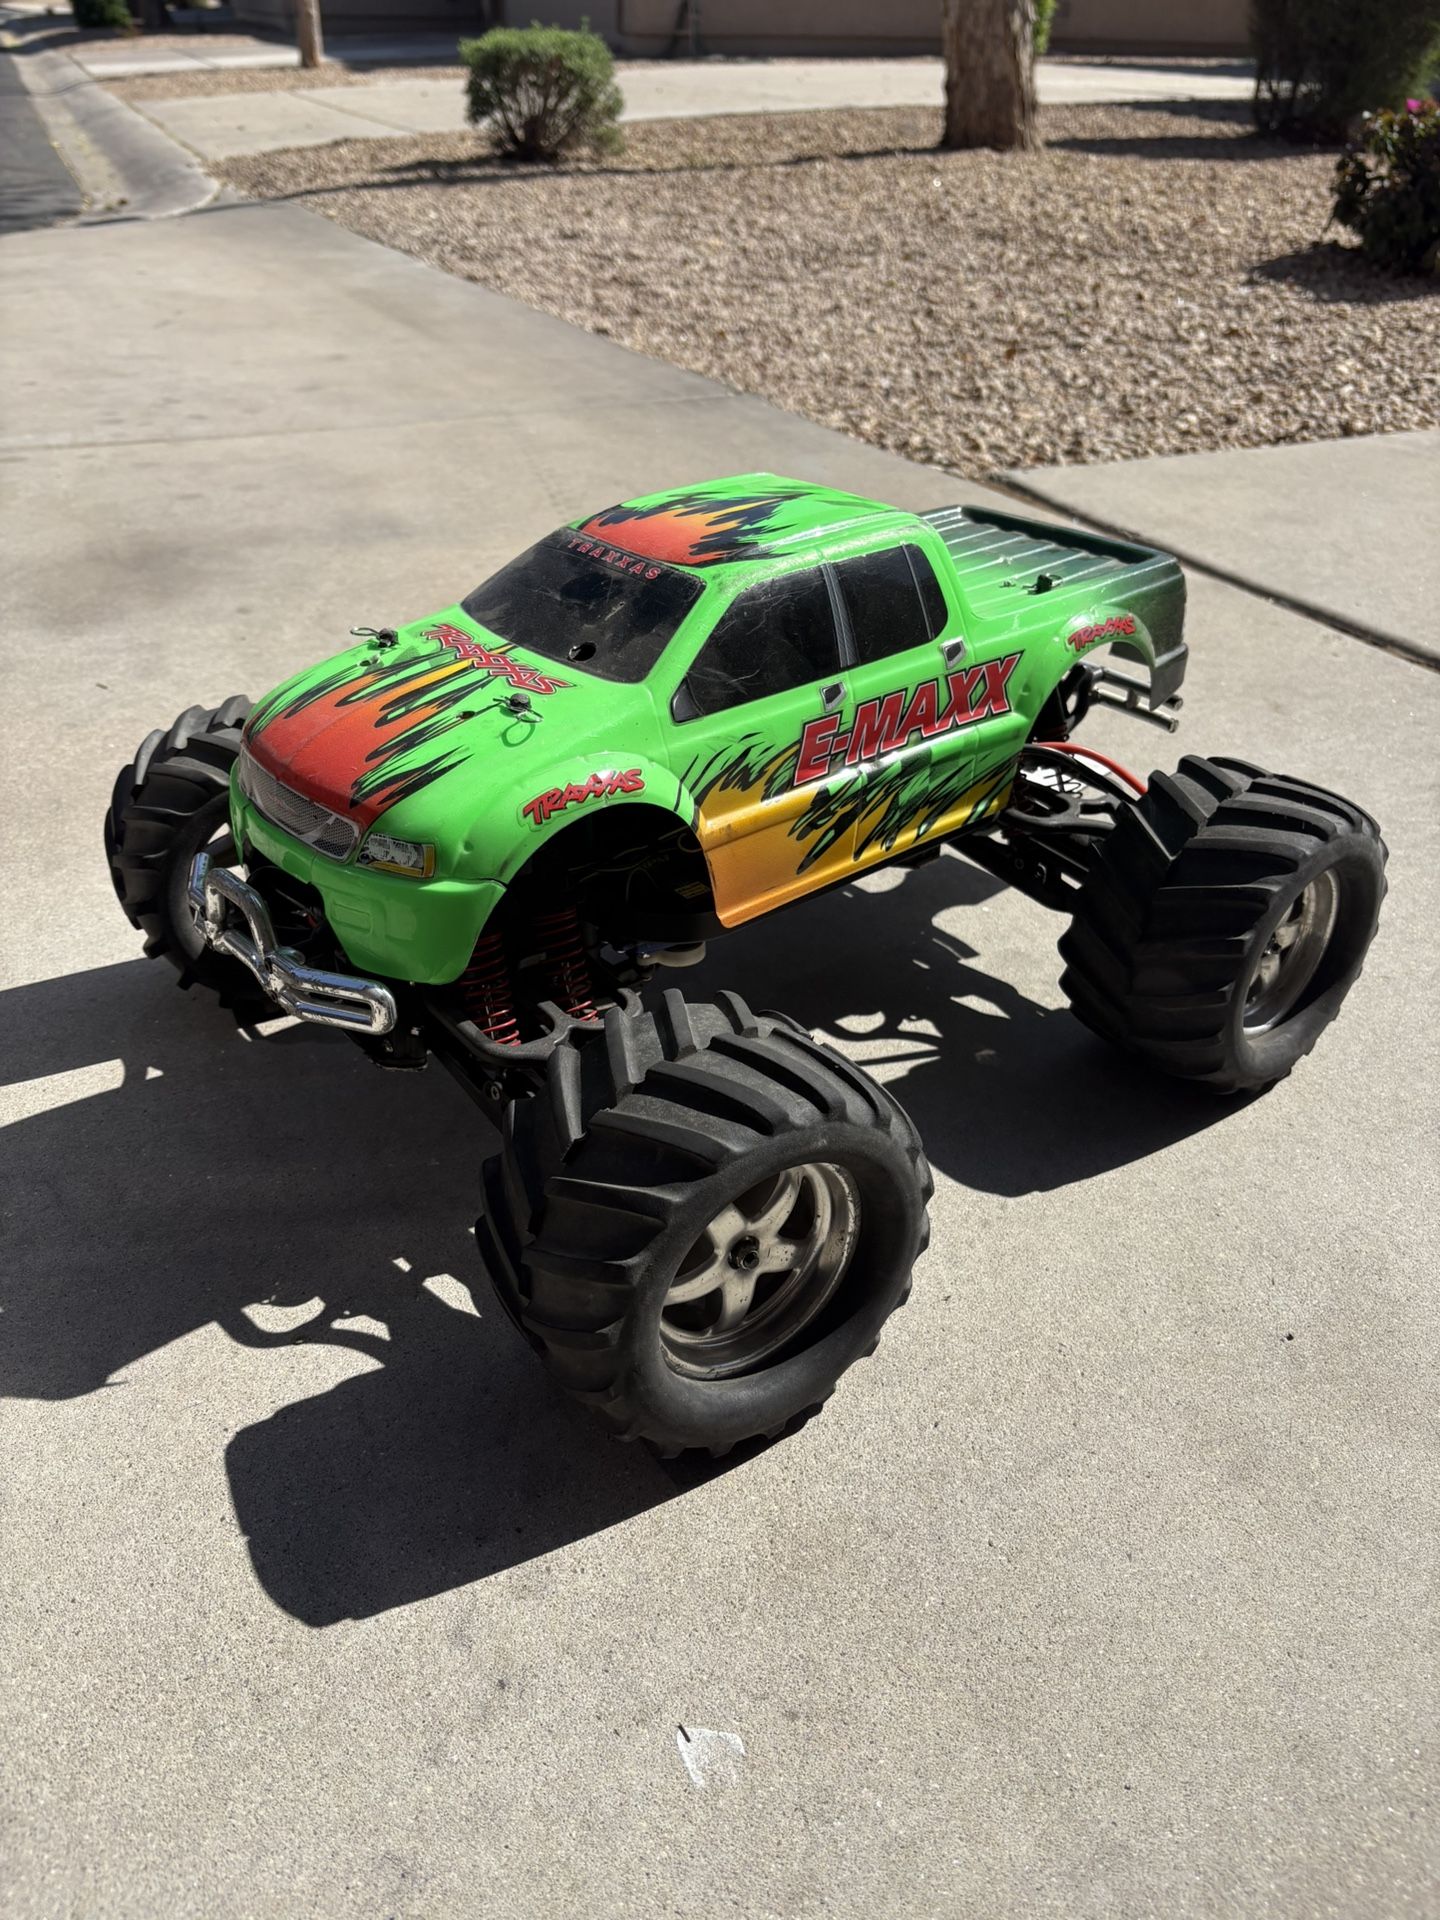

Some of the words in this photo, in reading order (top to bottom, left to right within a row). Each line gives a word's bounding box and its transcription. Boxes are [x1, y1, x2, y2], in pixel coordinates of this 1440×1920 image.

[568, 537, 661, 581] TRAXXAS
[421, 623, 575, 695] TRAXXAS
[1067, 616, 1136, 652] TRAXXAS
[793, 649, 1025, 786] E-MAXX
[523, 768, 645, 825] TRAXXAS
